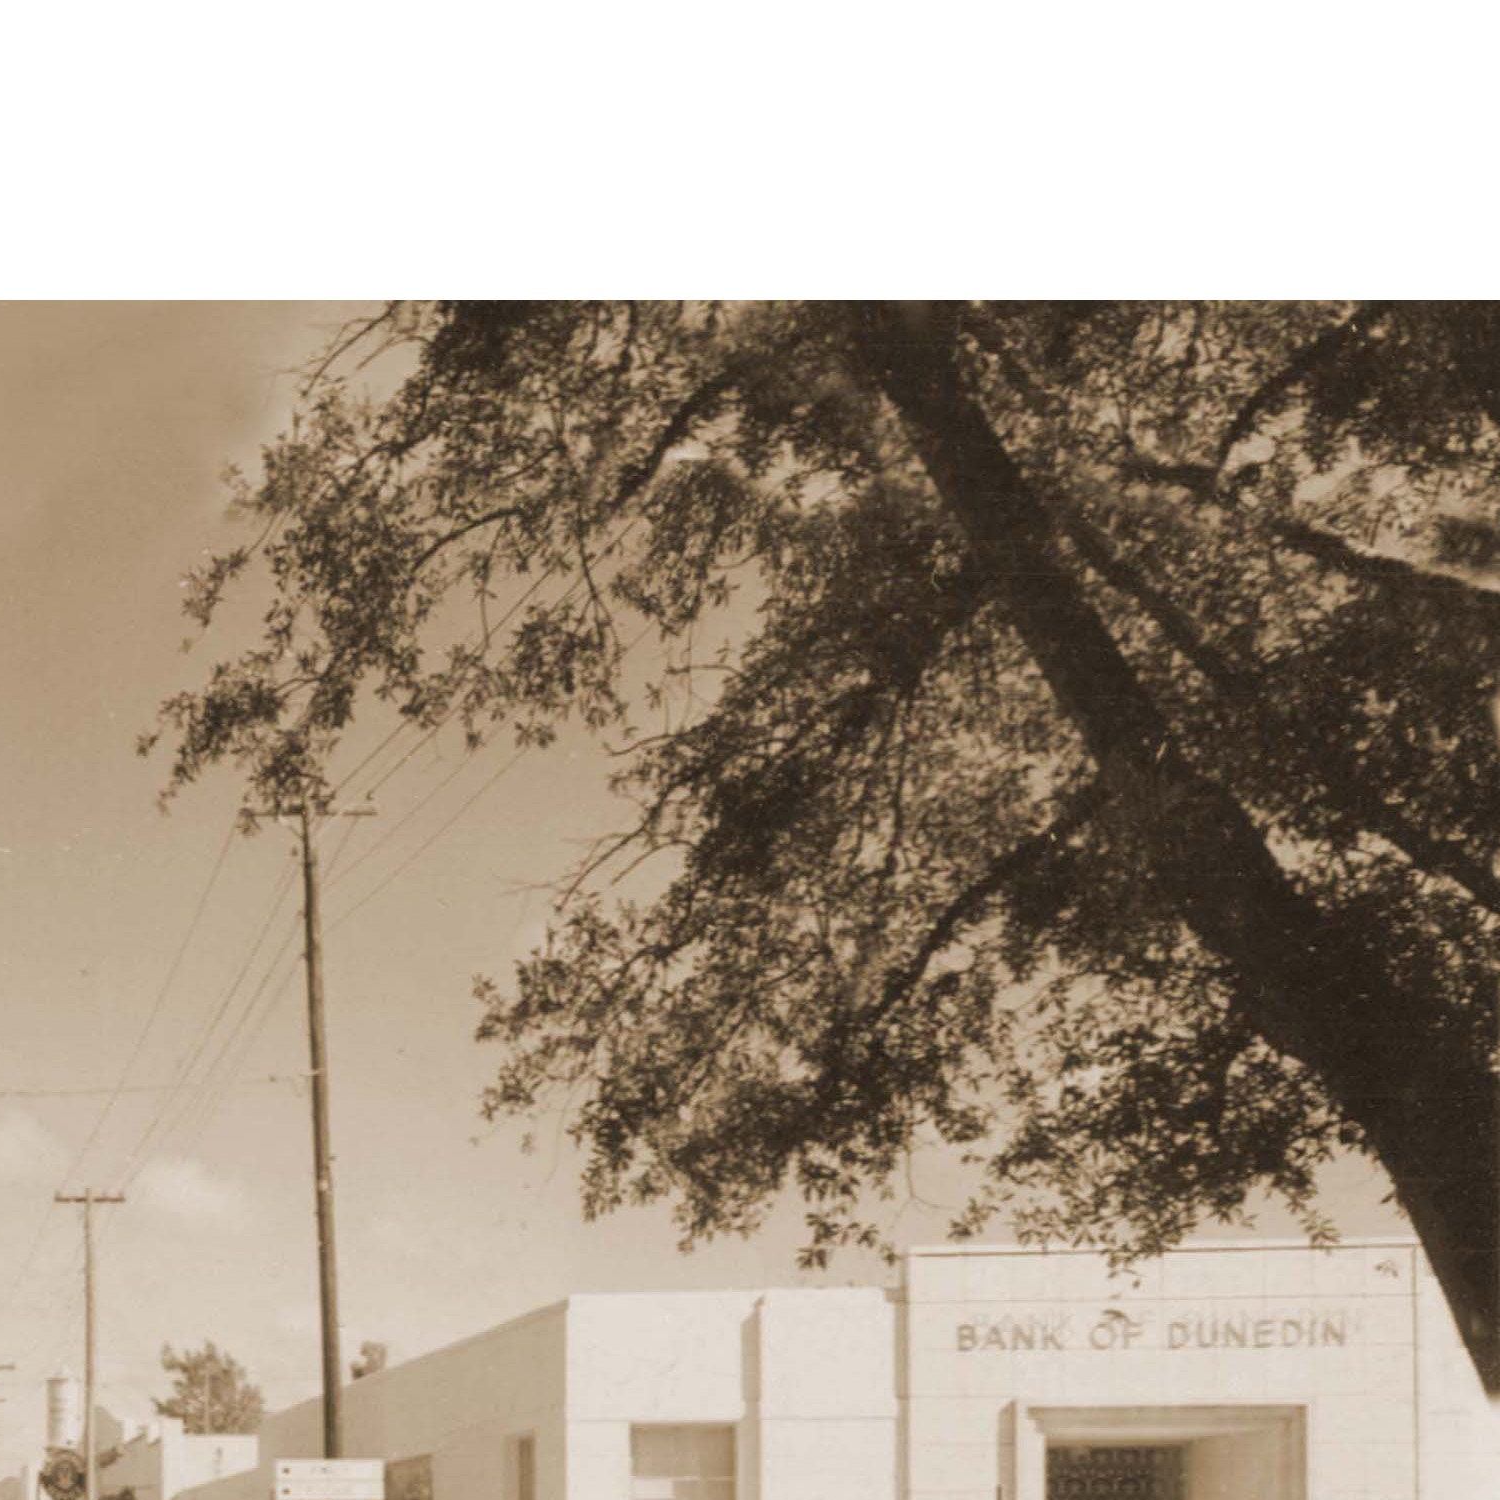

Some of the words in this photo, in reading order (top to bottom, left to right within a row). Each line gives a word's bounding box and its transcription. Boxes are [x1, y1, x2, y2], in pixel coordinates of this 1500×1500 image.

[955, 1323, 1064, 1353] BANK
[1088, 1318, 1145, 1352] OF
[1166, 1318, 1348, 1349] DUNEDIN
